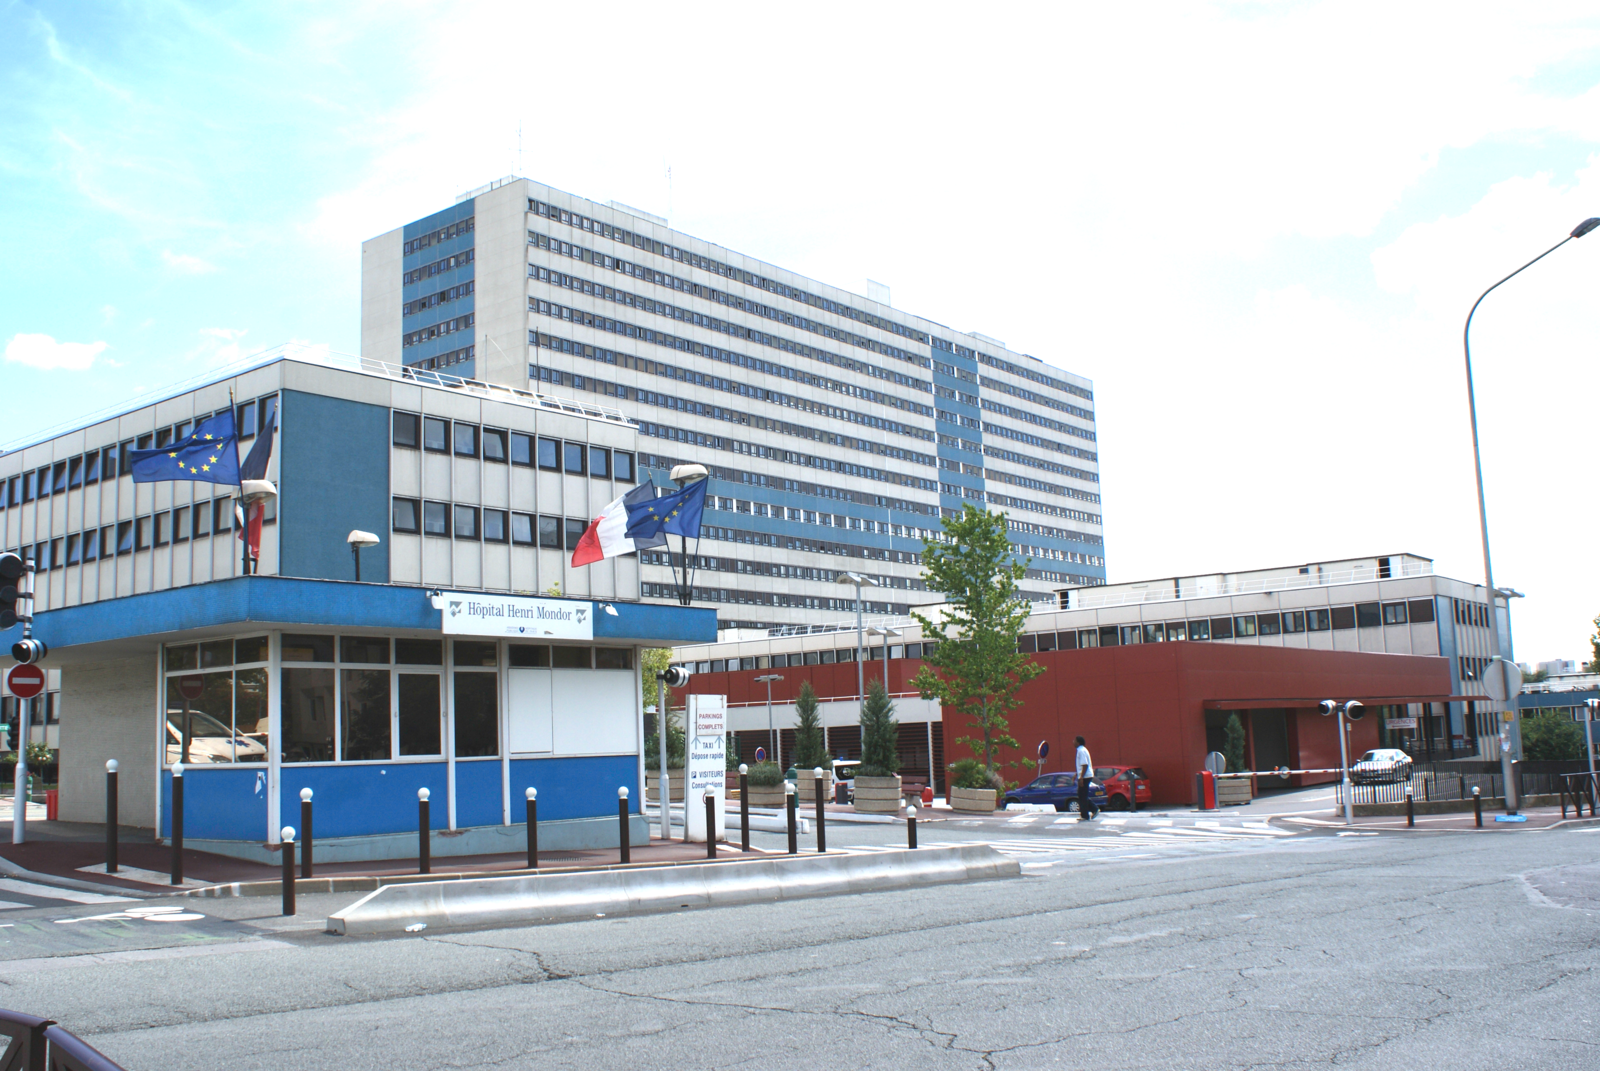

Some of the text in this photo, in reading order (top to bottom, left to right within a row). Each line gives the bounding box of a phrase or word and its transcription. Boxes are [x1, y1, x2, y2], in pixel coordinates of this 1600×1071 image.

[468, 602, 572, 620] Hôpital Henri Mondor
[691, 752, 724, 760] Dépose rapide
